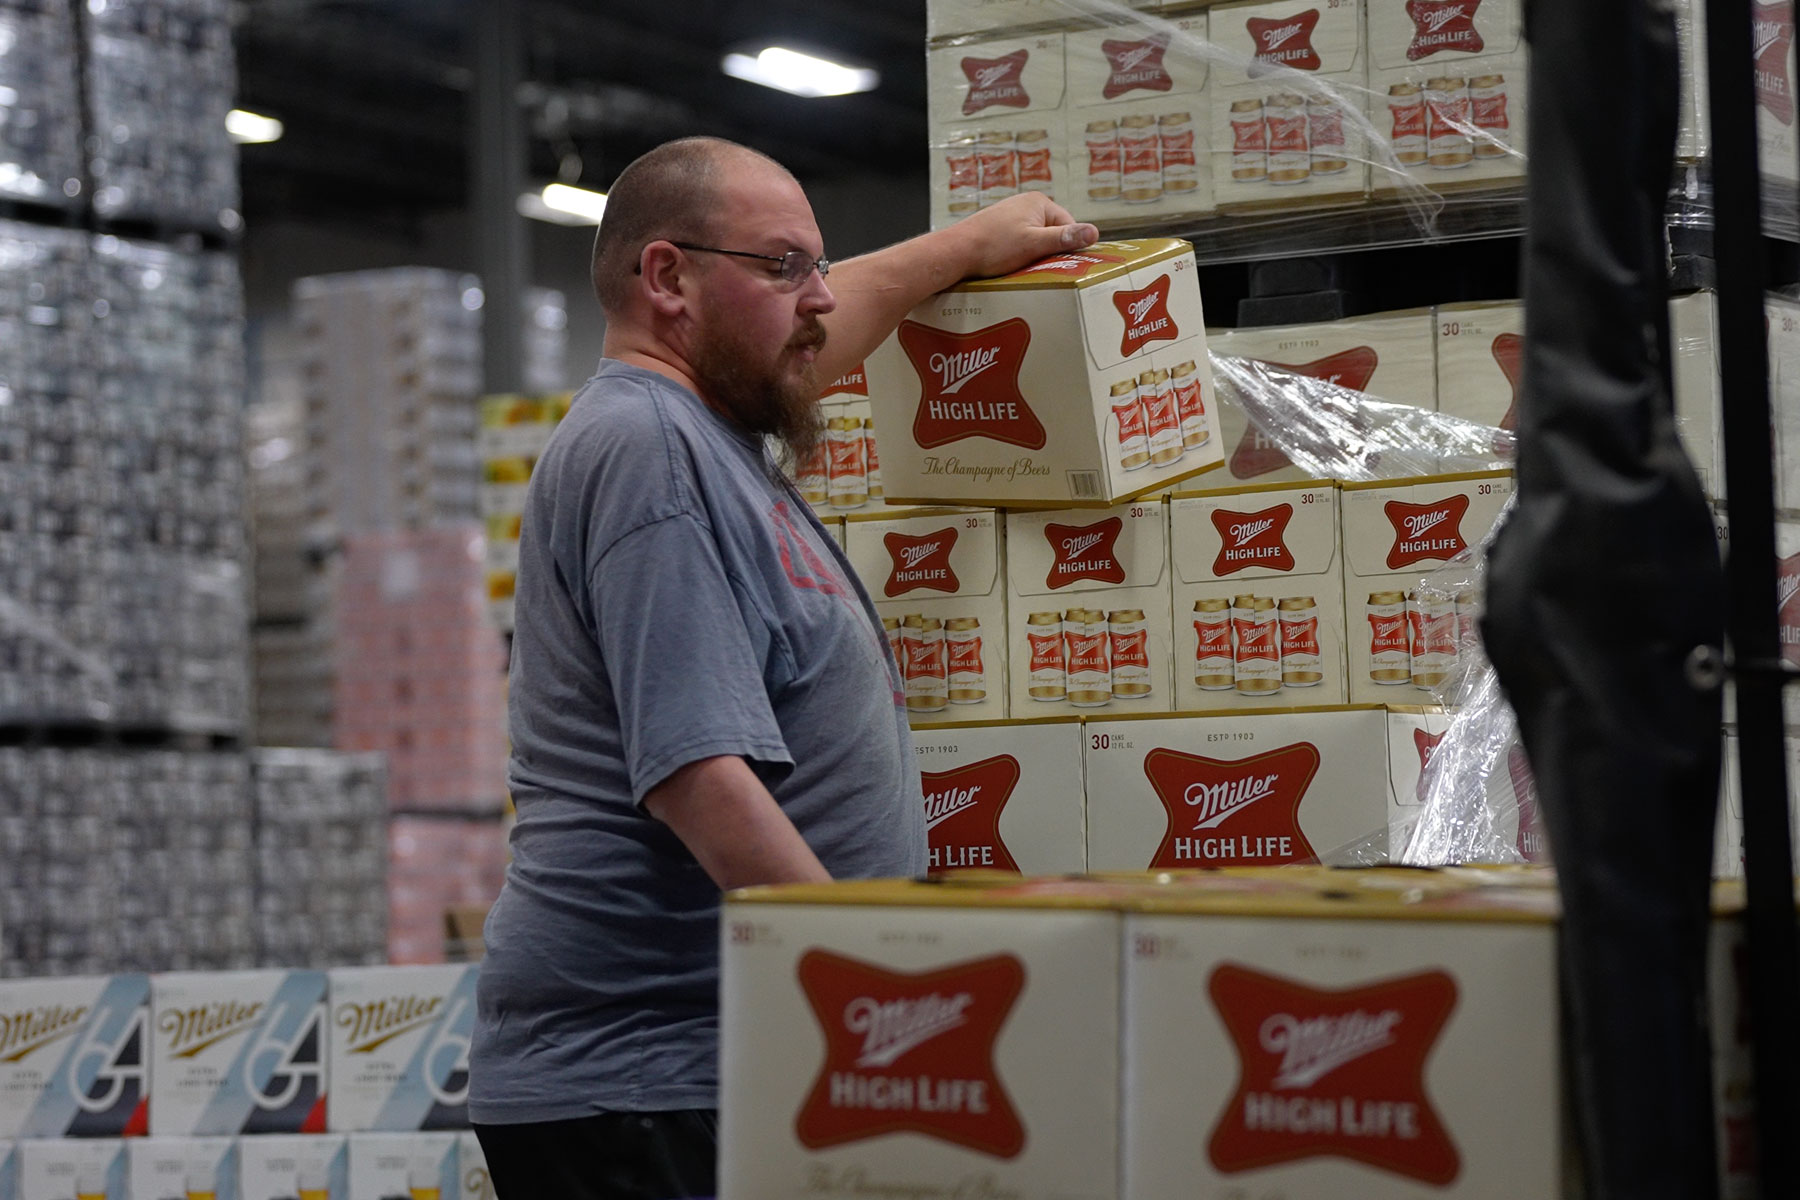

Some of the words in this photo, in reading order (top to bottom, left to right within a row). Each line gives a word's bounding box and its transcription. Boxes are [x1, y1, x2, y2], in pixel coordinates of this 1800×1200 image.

[1423, 5, 1464, 32] Miller
[1262, 23, 1302, 49] Miller
[1418, 33, 1446, 46] HIGH
[1447, 31, 1472, 42] LIFE
[1258, 50, 1285, 63] HIGH
[1286, 48, 1309, 60] LIFE
[1113, 72, 1139, 85] HIGH
[1139, 70, 1161, 82] LIFE
[1766, 72, 1784, 95] LIFE
[1174, 260, 1184, 272] 30
[1127, 291, 1159, 321] Miller
[1128, 323, 1151, 340] HIGH
[1150, 317, 1168, 331] LIFE
[1442, 323, 1459, 336] 30
[929, 346, 1001, 387] Miller
[842, 373, 863, 386] LIFE
[927, 400, 976, 421] HIGH
[977, 401, 1020, 421] LIFE
[921, 456, 944, 475] The
[944, 456, 1006, 482] Champagne
[1007, 459, 1019, 482] of
[1016, 457, 1050, 476] Beers
[1478, 484, 1491, 495] 30
[1301, 493, 1313, 504] 30
[1130, 507, 1143, 518] 30
[966, 518, 977, 528] 30
[1404, 509, 1449, 534] Miller
[1229, 518, 1274, 543] Miller
[1717, 525, 1729, 541] 30
[1062, 532, 1104, 555] Miller
[1400, 541, 1430, 553] HIGH
[1431, 539, 1457, 550] LIFE
[900, 542, 940, 565] Miller
[1225, 549, 1254, 561] HIGH
[1256, 547, 1281, 558] LIFE
[1058, 561, 1086, 574] HIGH
[1087, 559, 1111, 571] LIFE
[896, 570, 923, 582] HIGH
[924, 568, 947, 580] LIFE
[1202, 627, 1227, 641] Miller
[1242, 626, 1269, 641] Miller
[1286, 623, 1310, 637] Miller
[1376, 620, 1402, 634] Miller
[1240, 645, 1258, 653] HIGH
[1259, 644, 1274, 652] LIFE
[1300, 640, 1314, 648] LIFE
[1374, 638, 1391, 646] HIGH
[909, 663, 926, 671] HIGH
[950, 659, 966, 667] HIGH
[1034, 656, 1048, 664] HIGH
[1071, 657, 1088, 665] HIGH
[1089, 656, 1104, 664] LIFE
[1091, 734, 1110, 750] 30
[1207, 734, 1229, 742] ESTD
[1233, 733, 1254, 741] 1903
[938, 745, 958, 754] 1903
[1184, 774, 1279, 822] Miller
[1175, 837, 1235, 860] HIGH
[1241, 835, 1293, 857] LIFE
[945, 845, 994, 866] LIFE
[158, 1002, 263, 1049] Miller
[337, 997, 442, 1043] Miller
[844, 992, 974, 1054] Miller
[830, 1071, 914, 1110] HIGH
[917, 1074, 989, 1115] LIFE
[1244, 1091, 1337, 1134] HIGH
[1341, 1095, 1422, 1139] LIFE
